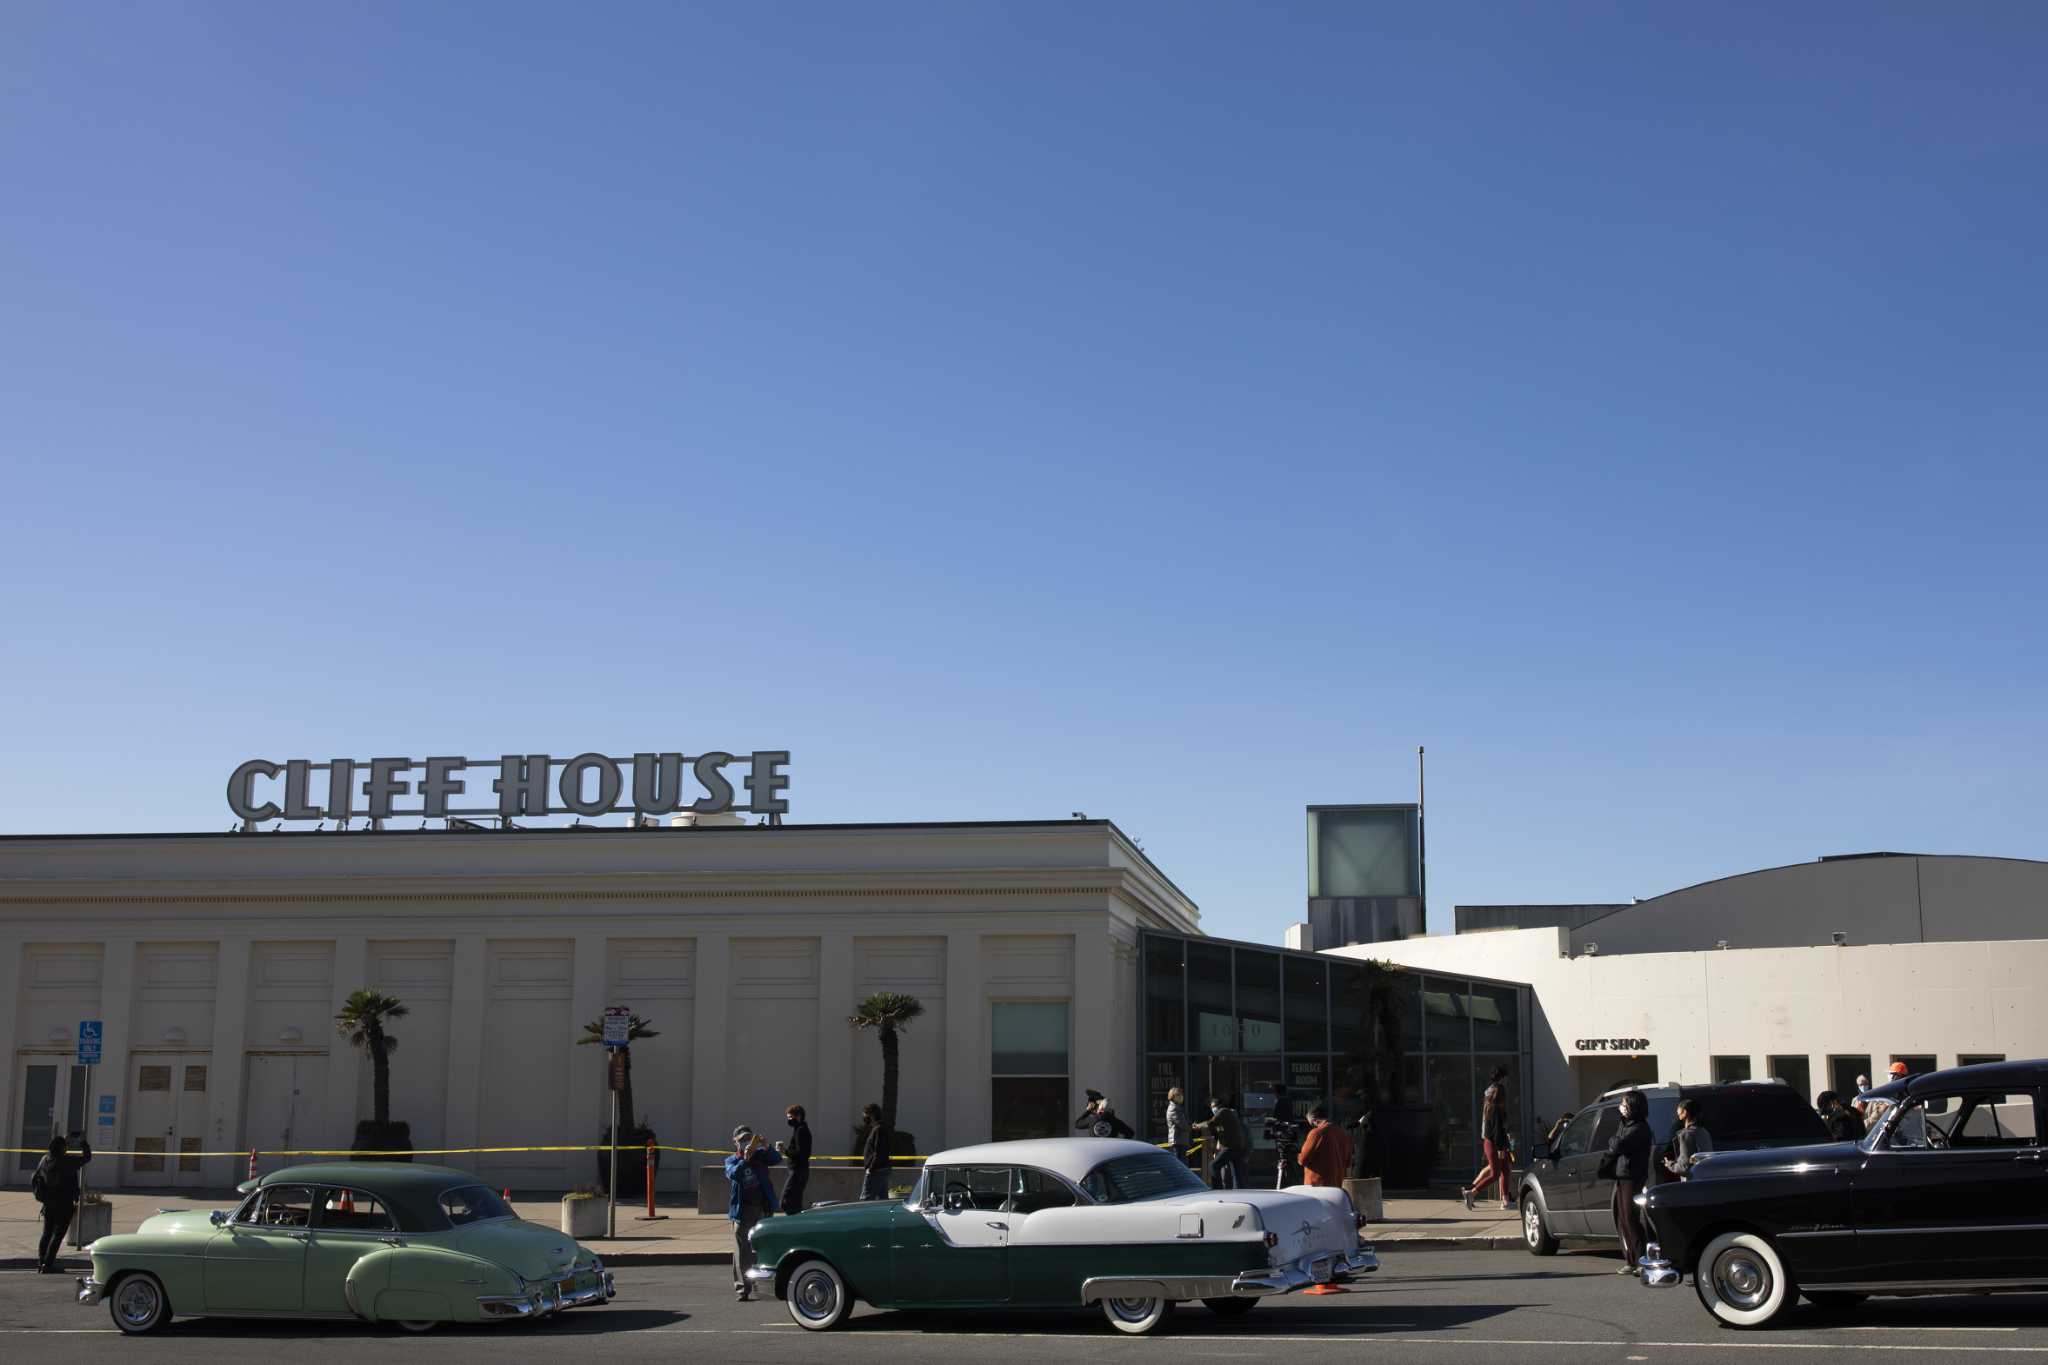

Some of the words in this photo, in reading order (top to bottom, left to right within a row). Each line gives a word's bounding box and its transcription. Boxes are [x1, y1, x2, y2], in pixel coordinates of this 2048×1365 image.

[227, 757, 465, 822] CLIFF
[493, 751, 790, 816] HOUSE
[1575, 1039, 1608, 1050] GIFT
[1609, 1039, 1650, 1050] SHOP
